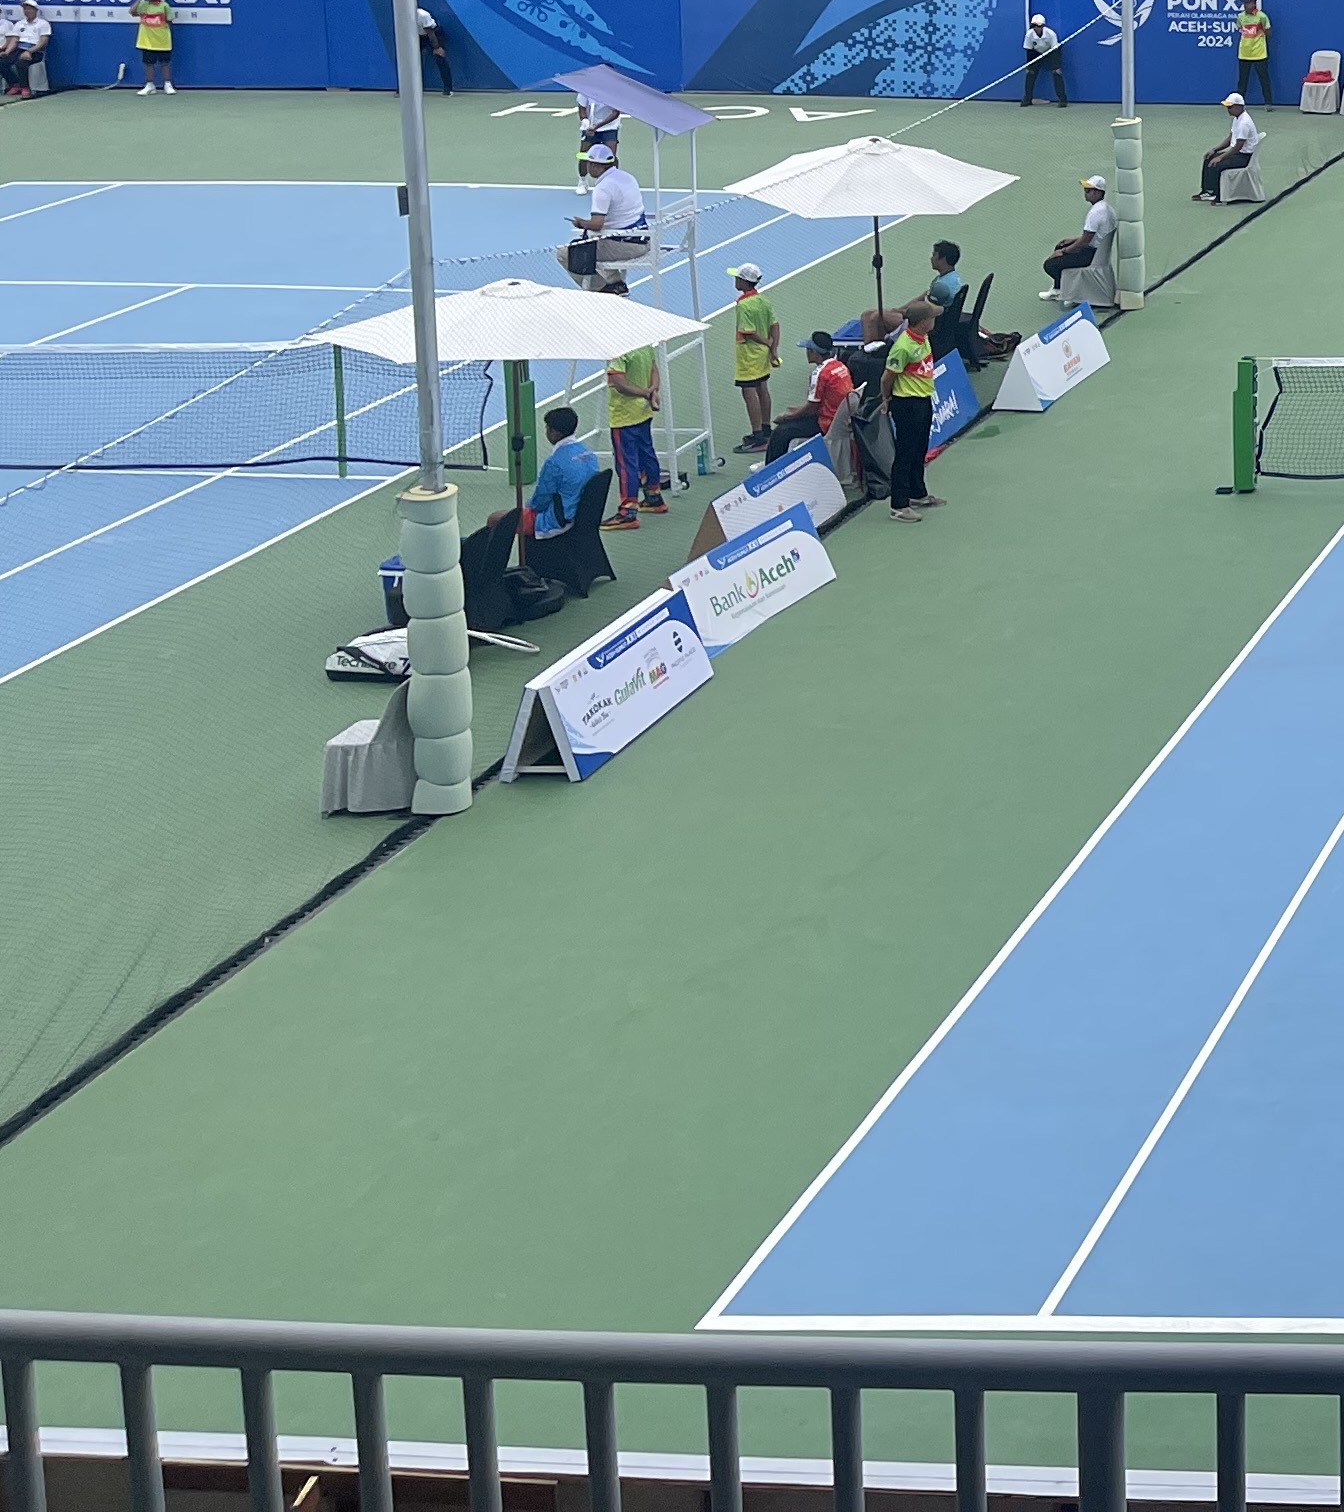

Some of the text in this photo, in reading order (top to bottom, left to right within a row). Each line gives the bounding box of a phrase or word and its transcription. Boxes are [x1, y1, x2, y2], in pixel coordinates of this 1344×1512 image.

[1168, 20, 1242, 33] ACEH-SUM
[1197, 35, 1233, 48] 2024
[709, 554, 796, 617] Bank Aceh
